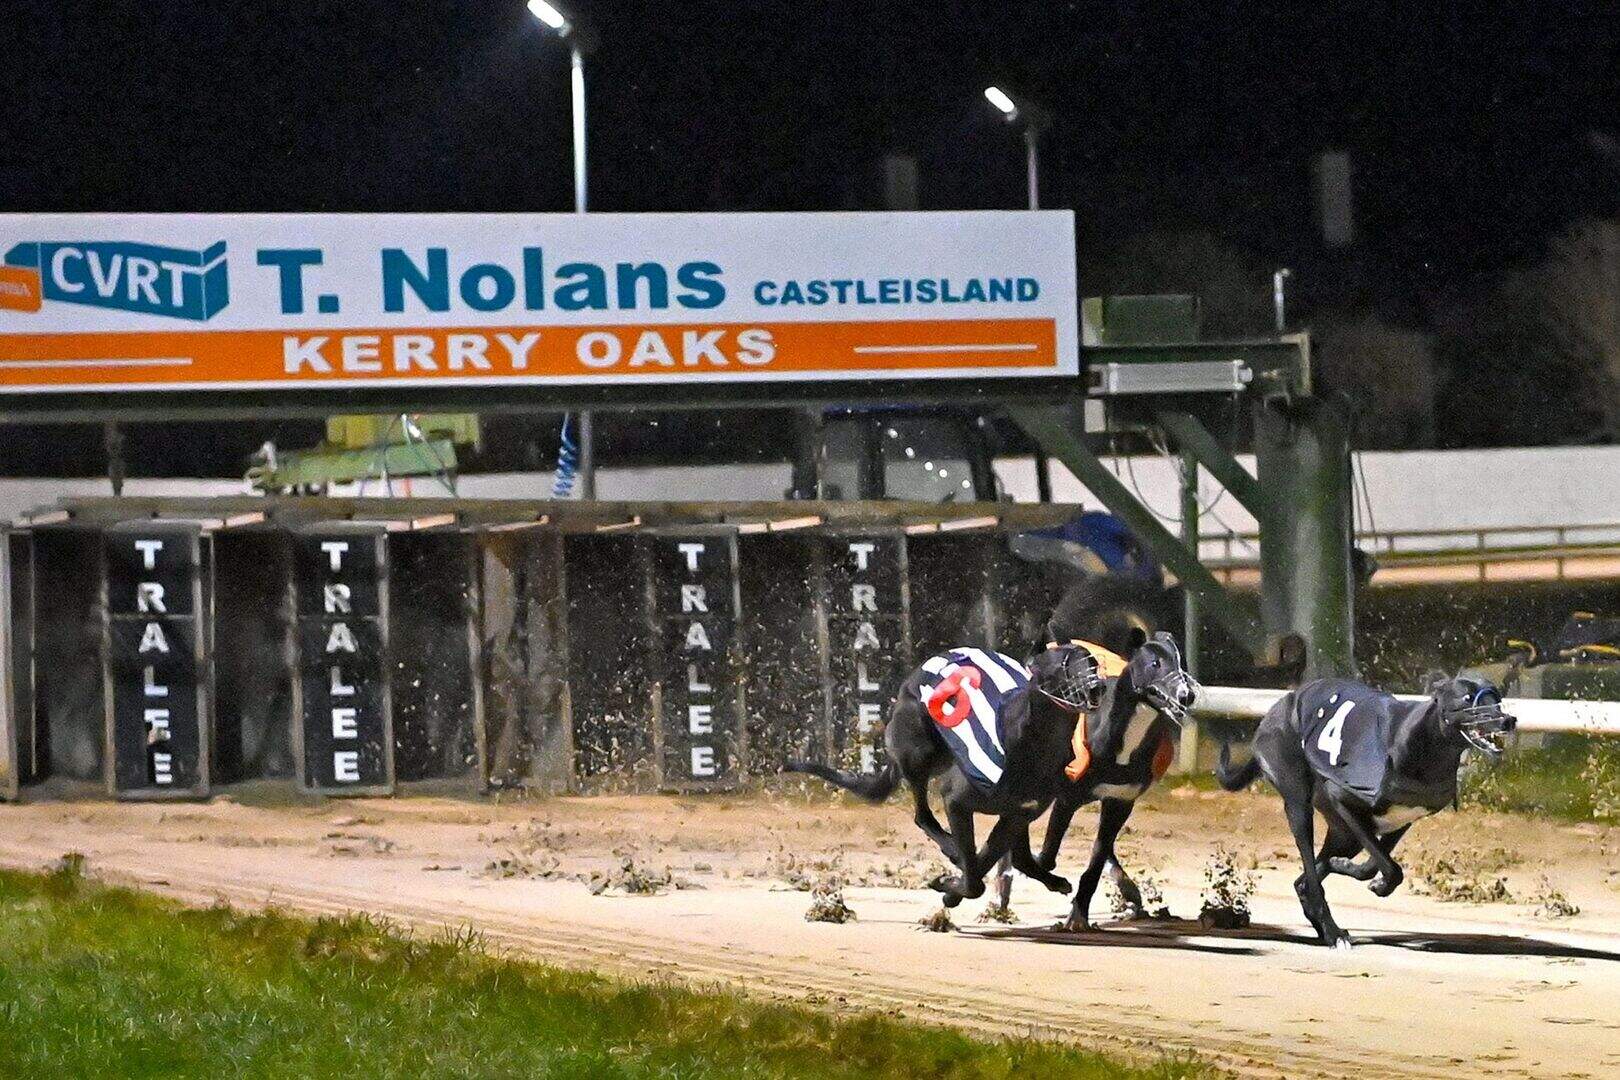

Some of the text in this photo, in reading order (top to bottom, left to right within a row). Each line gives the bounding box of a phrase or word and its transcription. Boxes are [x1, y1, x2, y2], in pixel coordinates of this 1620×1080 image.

[51, 247, 201, 307] CVRT
[257, 246, 1041, 314] T. Nolans CASTLEISLAND
[282, 328, 777, 374] KERRY OAKS
[134, 539, 174, 785] TRALEE
[321, 541, 361, 783] TRALEE
[677, 542, 717, 776] TRALEE
[927, 665, 982, 728] 6
[1316, 699, 1356, 766] 4
